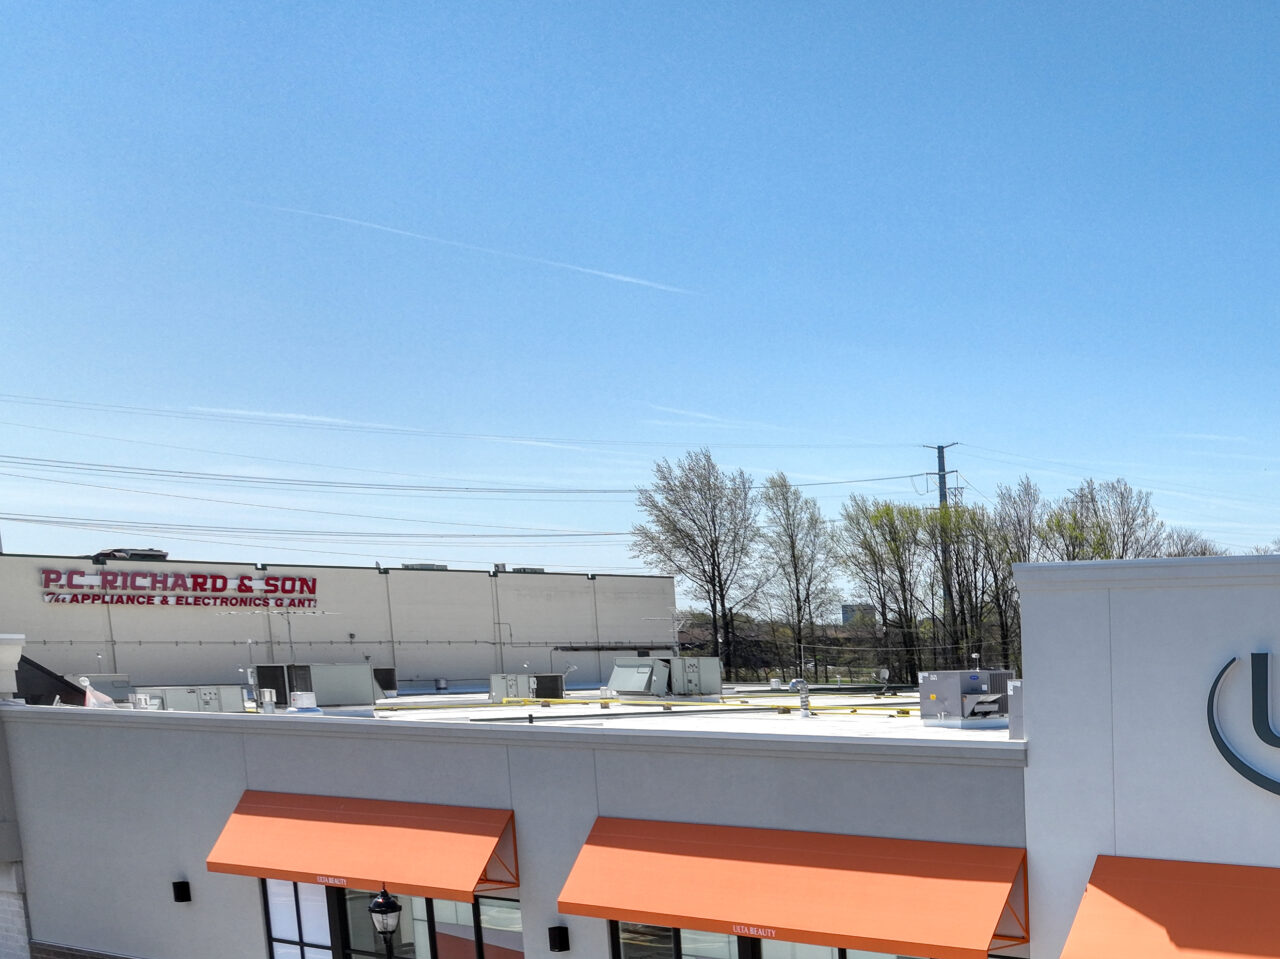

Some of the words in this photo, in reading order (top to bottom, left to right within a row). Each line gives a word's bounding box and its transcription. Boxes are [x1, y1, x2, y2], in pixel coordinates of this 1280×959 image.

[41, 569, 95, 590] P.C.
[99, 571, 229, 593] RICHARD
[237, 575, 254, 593] &
[263, 576, 317, 595] SON
[45, 592, 66, 603] The
[69, 593, 156, 606] APPLIANCE
[160, 595, 170, 606] &
[175, 595, 271, 607] ELECTRONICS
[749, 926, 777, 938] BEAUTY
